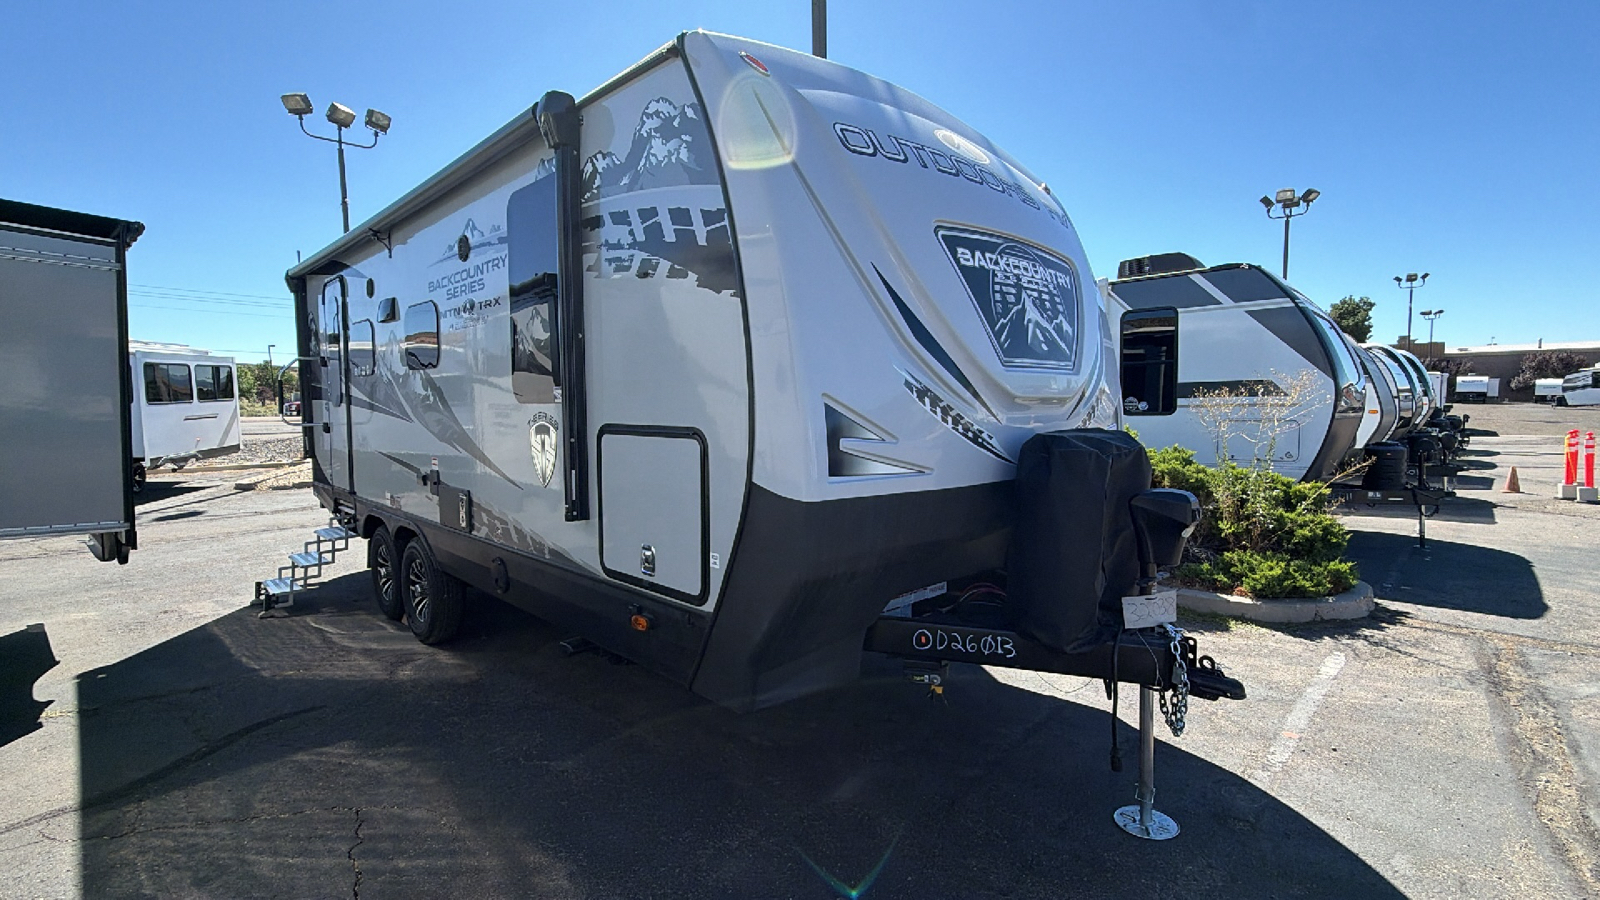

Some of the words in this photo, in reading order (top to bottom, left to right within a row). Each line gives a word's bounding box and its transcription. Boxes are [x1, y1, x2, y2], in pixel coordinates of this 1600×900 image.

[833, 121, 1040, 211] OUTDOORS
[428, 253, 508, 293] BACKCOUNTRY
[956, 246, 1071, 289] BACKCOUNTRY
[446, 278, 485, 300] SERIES
[477, 296, 501, 310] TRX
